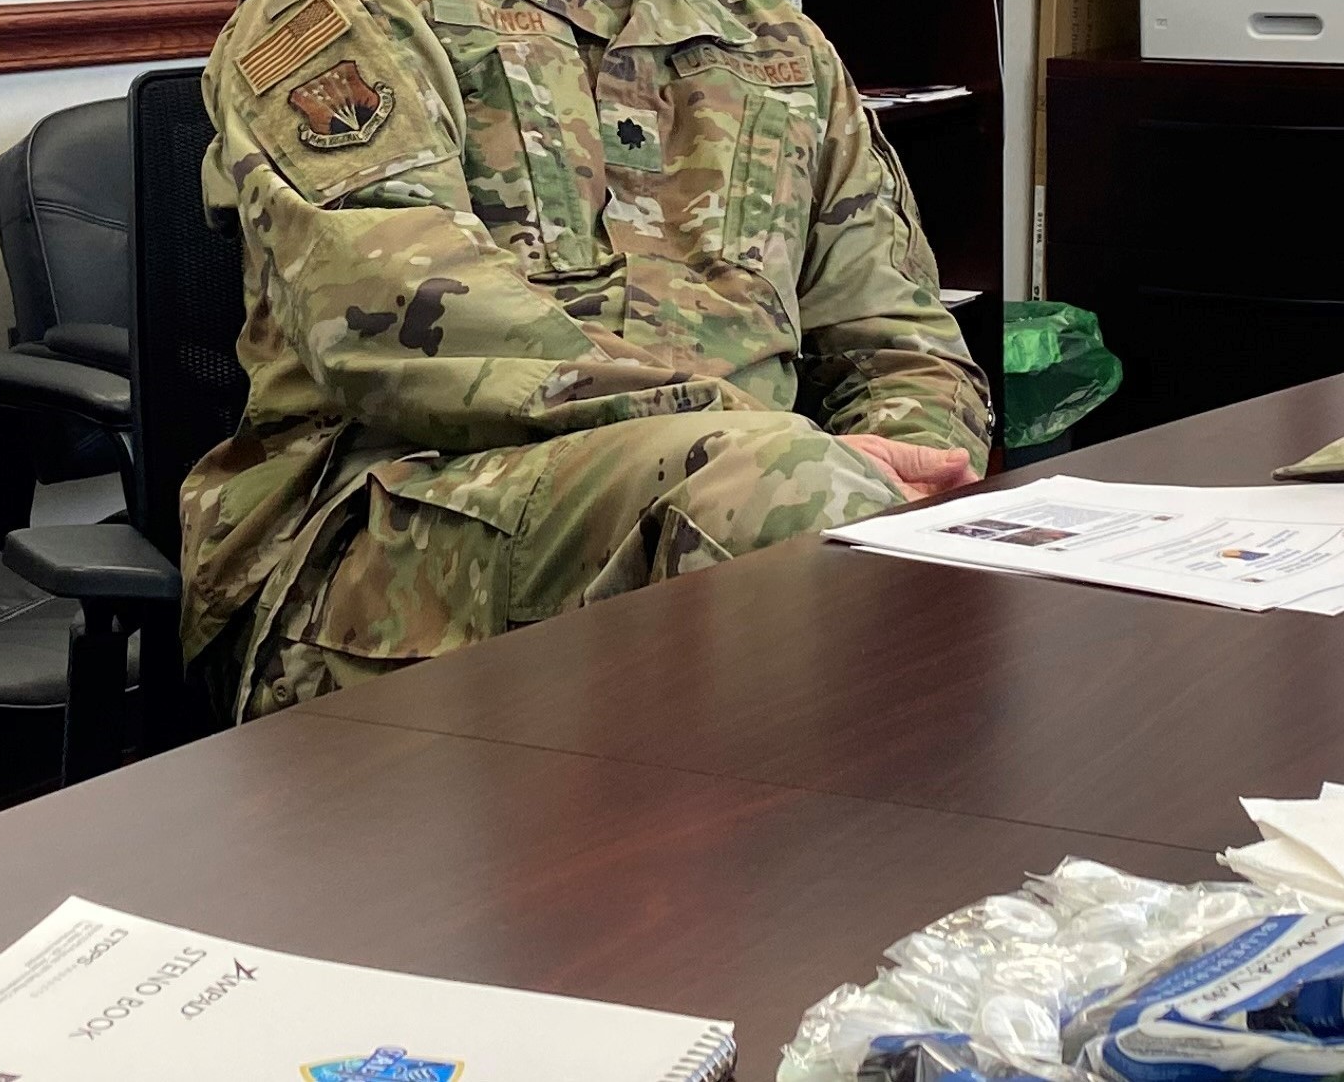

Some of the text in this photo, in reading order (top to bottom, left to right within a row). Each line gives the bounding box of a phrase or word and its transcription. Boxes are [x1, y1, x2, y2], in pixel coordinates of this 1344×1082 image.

[477, 1, 546, 33] LYNCH
[741, 61, 805, 85] FORCE
[135, 945, 208, 996] STENO
[180, 957, 260, 1020] AMPAD
[68, 995, 145, 1041] BOOK
